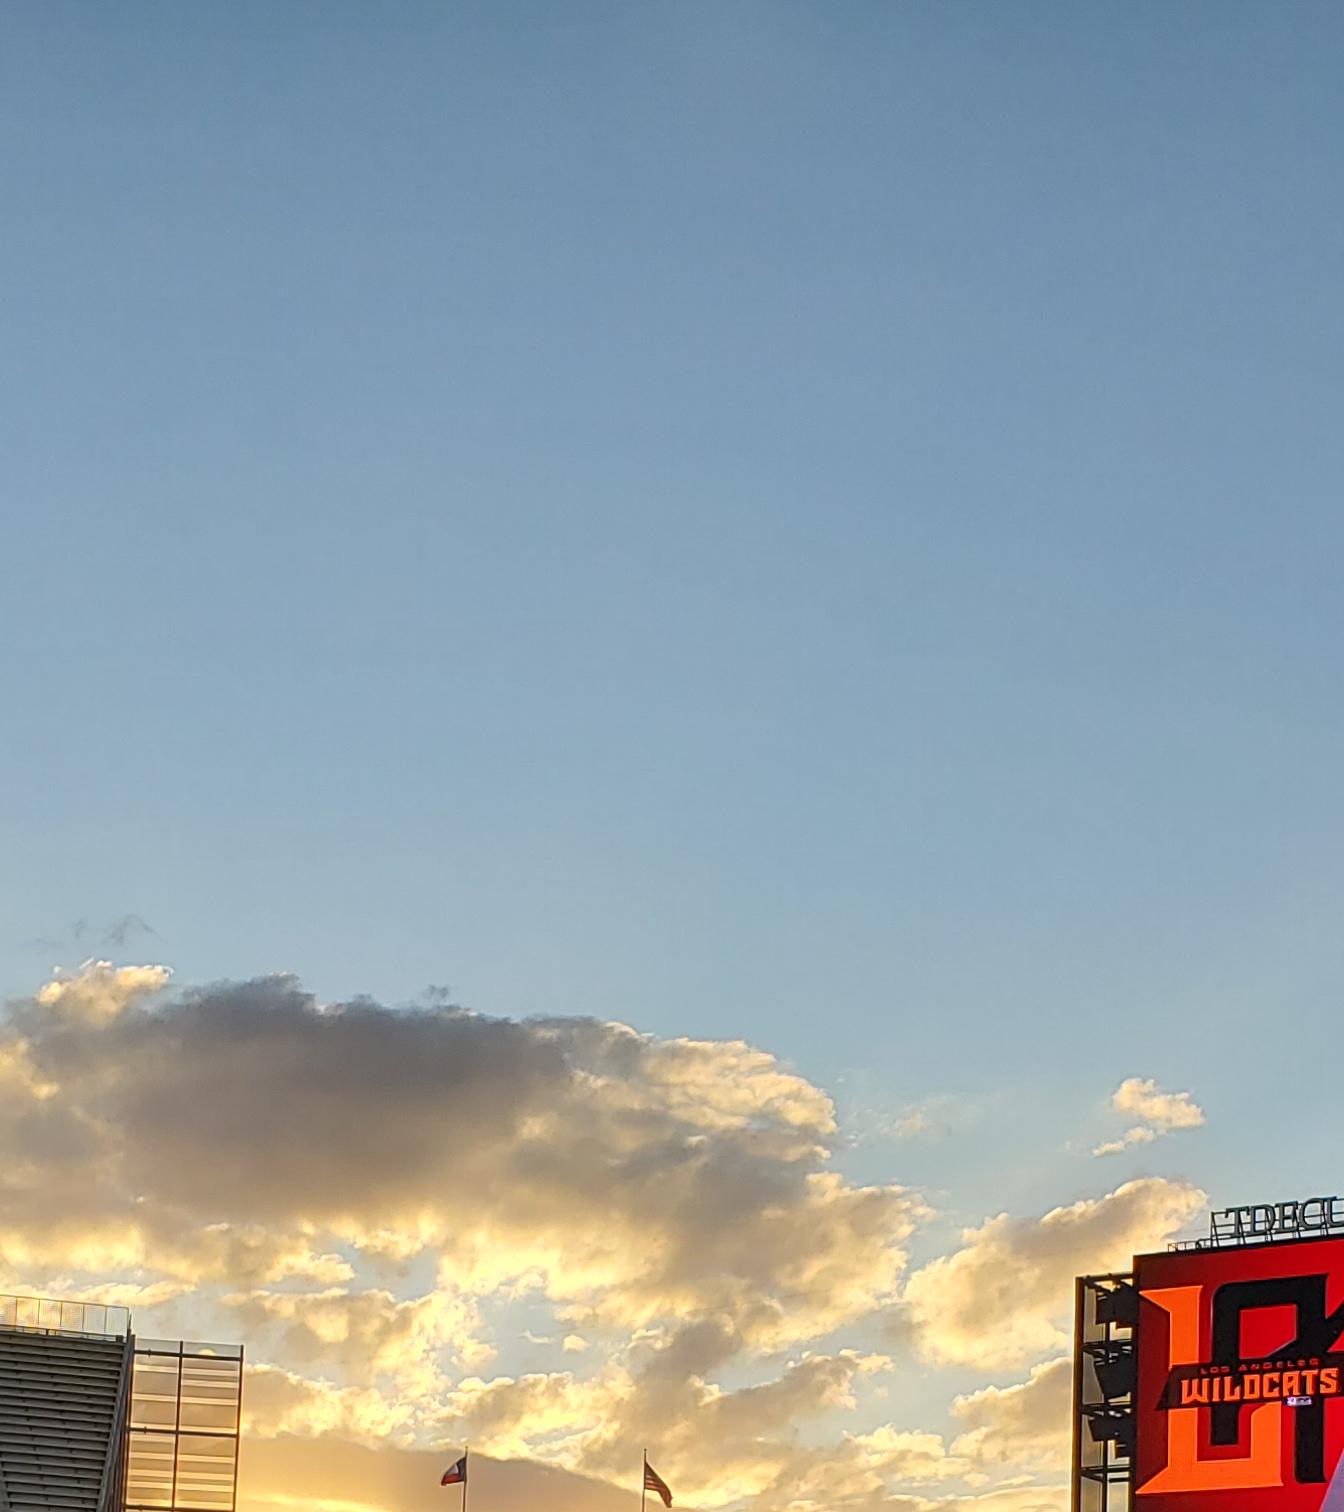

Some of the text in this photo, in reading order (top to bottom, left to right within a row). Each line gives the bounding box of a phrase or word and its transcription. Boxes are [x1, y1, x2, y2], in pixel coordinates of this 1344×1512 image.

[1200, 1357, 1321, 1375] LOS ANGELES
[1181, 1367, 1339, 1404] WILDCATS
